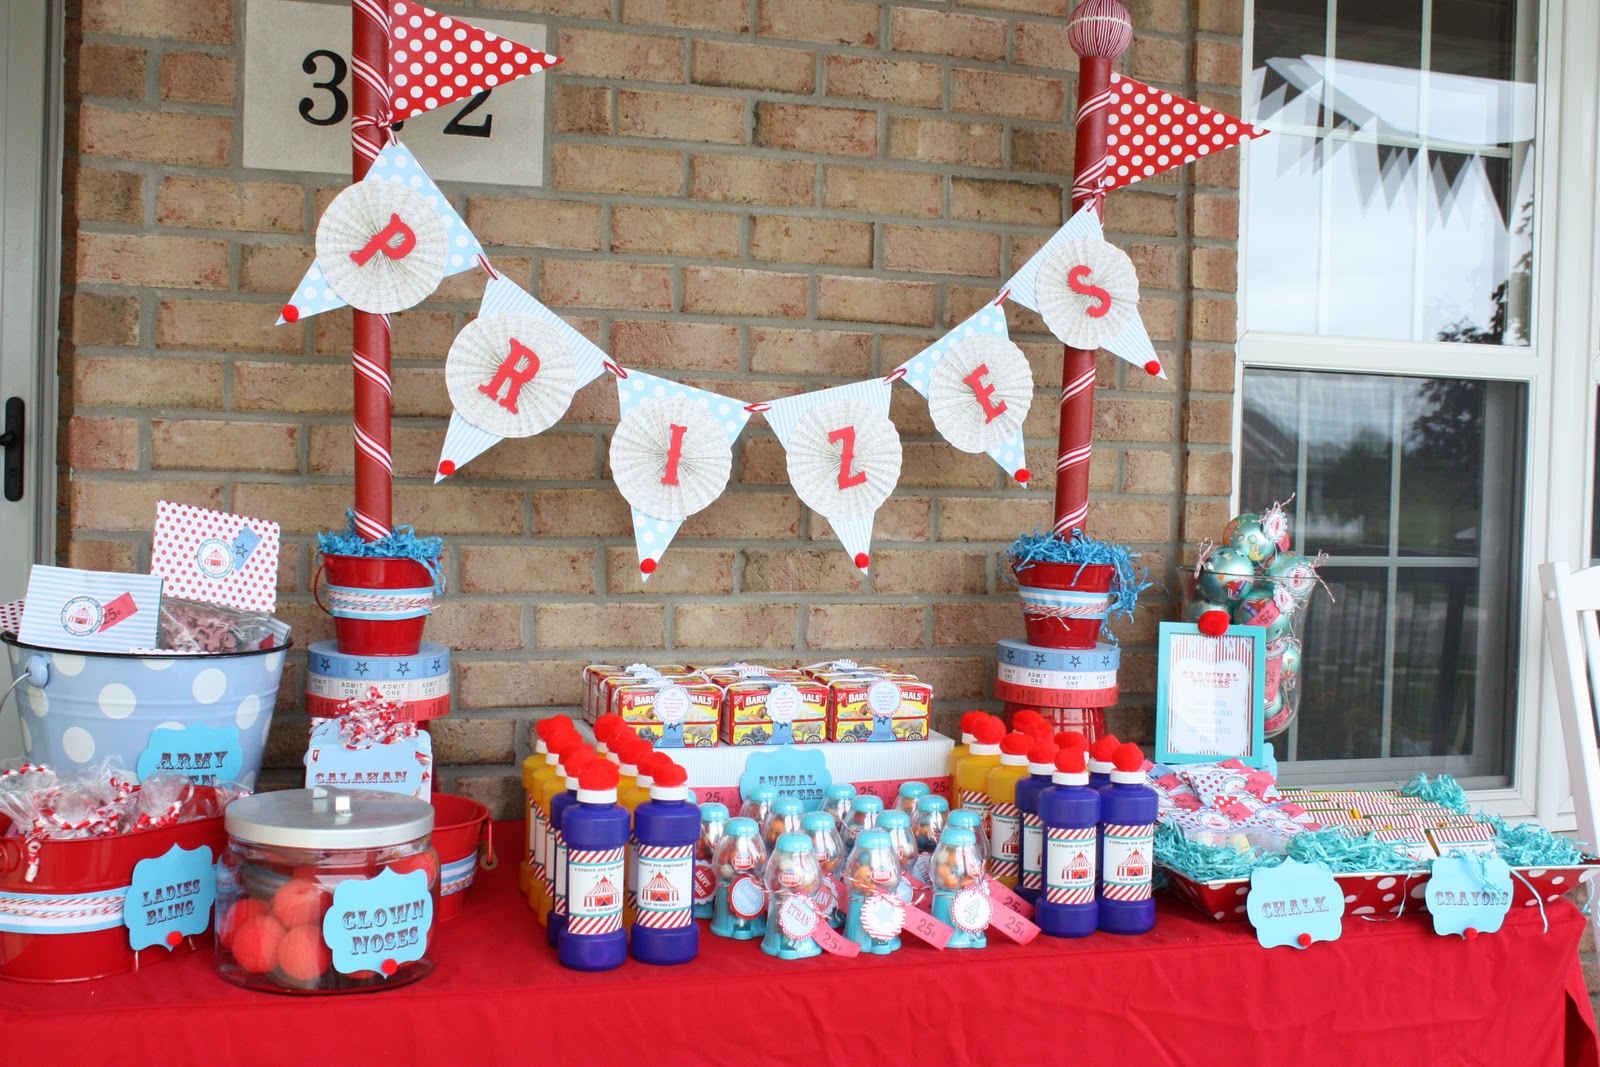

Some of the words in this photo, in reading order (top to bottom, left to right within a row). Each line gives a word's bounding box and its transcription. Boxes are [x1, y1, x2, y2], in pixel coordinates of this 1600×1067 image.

[299, 49, 493, 138] 32
[421, 680, 438, 688] ADMIT
[691, 694, 712, 705] MALS
[801, 692, 820, 703] MALS
[901, 691, 922, 702] MALS
[156, 751, 228, 770] ARMY
[188, 774, 217, 787] EN
[315, 771, 408, 784] CALAHAN
[759, 774, 817, 787] ANIMAL
[778, 788, 824, 801] CKERS
[695, 869, 711, 888] HAPPY
[142, 878, 201, 907] LADIES
[1435, 890, 1509, 906] CRAYONS
[146, 900, 195, 926] BLING
[342, 899, 425, 930] CLOWN
[786, 902, 811, 928] ETHAN
[964, 899, 980, 925] 4
[1261, 895, 1330, 919] CHALK
[916, 918, 936, 938] 25¢
[1004, 916, 1024, 936] 25¢
[351, 926, 419, 955] NOSES
